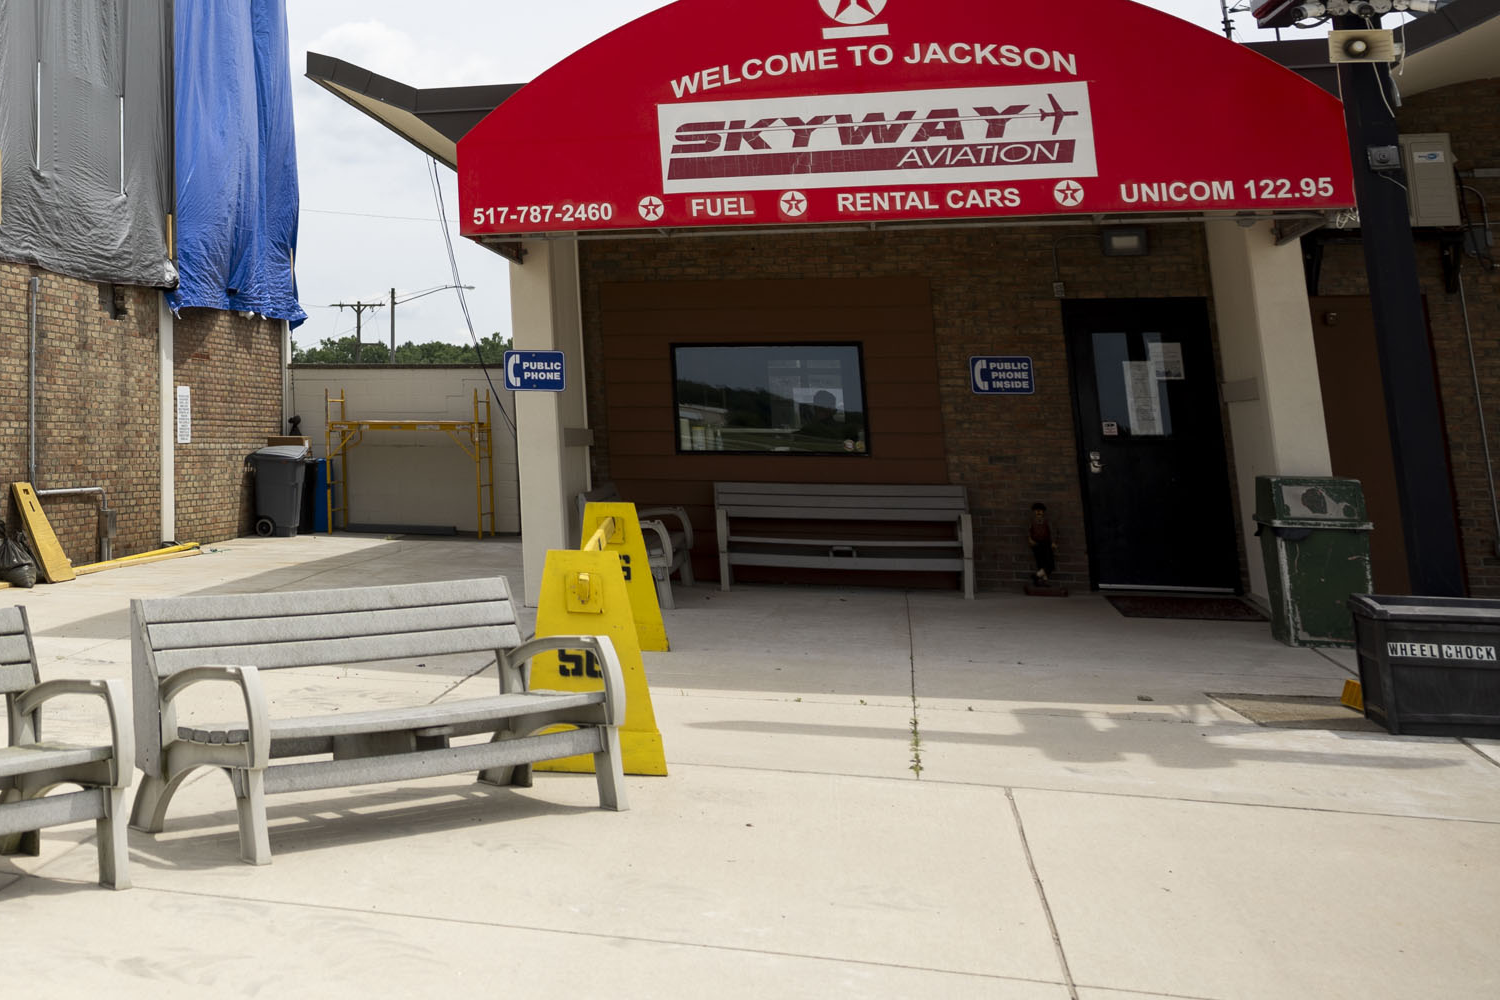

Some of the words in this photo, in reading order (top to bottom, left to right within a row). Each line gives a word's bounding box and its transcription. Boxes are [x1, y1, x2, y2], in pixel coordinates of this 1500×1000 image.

[670, 47, 839, 99] WELCOME
[847, 44, 894, 67] TO
[904, 42, 1078, 76] JACKSON
[671, 104, 1031, 154] SKYWAY
[896, 142, 1060, 168] AVIATION
[837, 191, 939, 212] RENTAL
[946, 187, 1022, 209] CARS
[1120, 180, 1235, 203] UNICOM
[1244, 177, 1334, 200] 122.95
[473, 203, 613, 226] 517-787-2460
[691, 197, 754, 217] FUEL
[522, 361, 562, 370] PUBLIC
[524, 371, 561, 380] PHONE
[989, 362, 1029, 370] PUBLIC
[991, 371, 1029, 379] PHONE
[992, 380, 1029, 389] INSIDE
[1388, 643, 1437, 658] WHEEL
[1444, 645, 1495, 660] CHOCK
